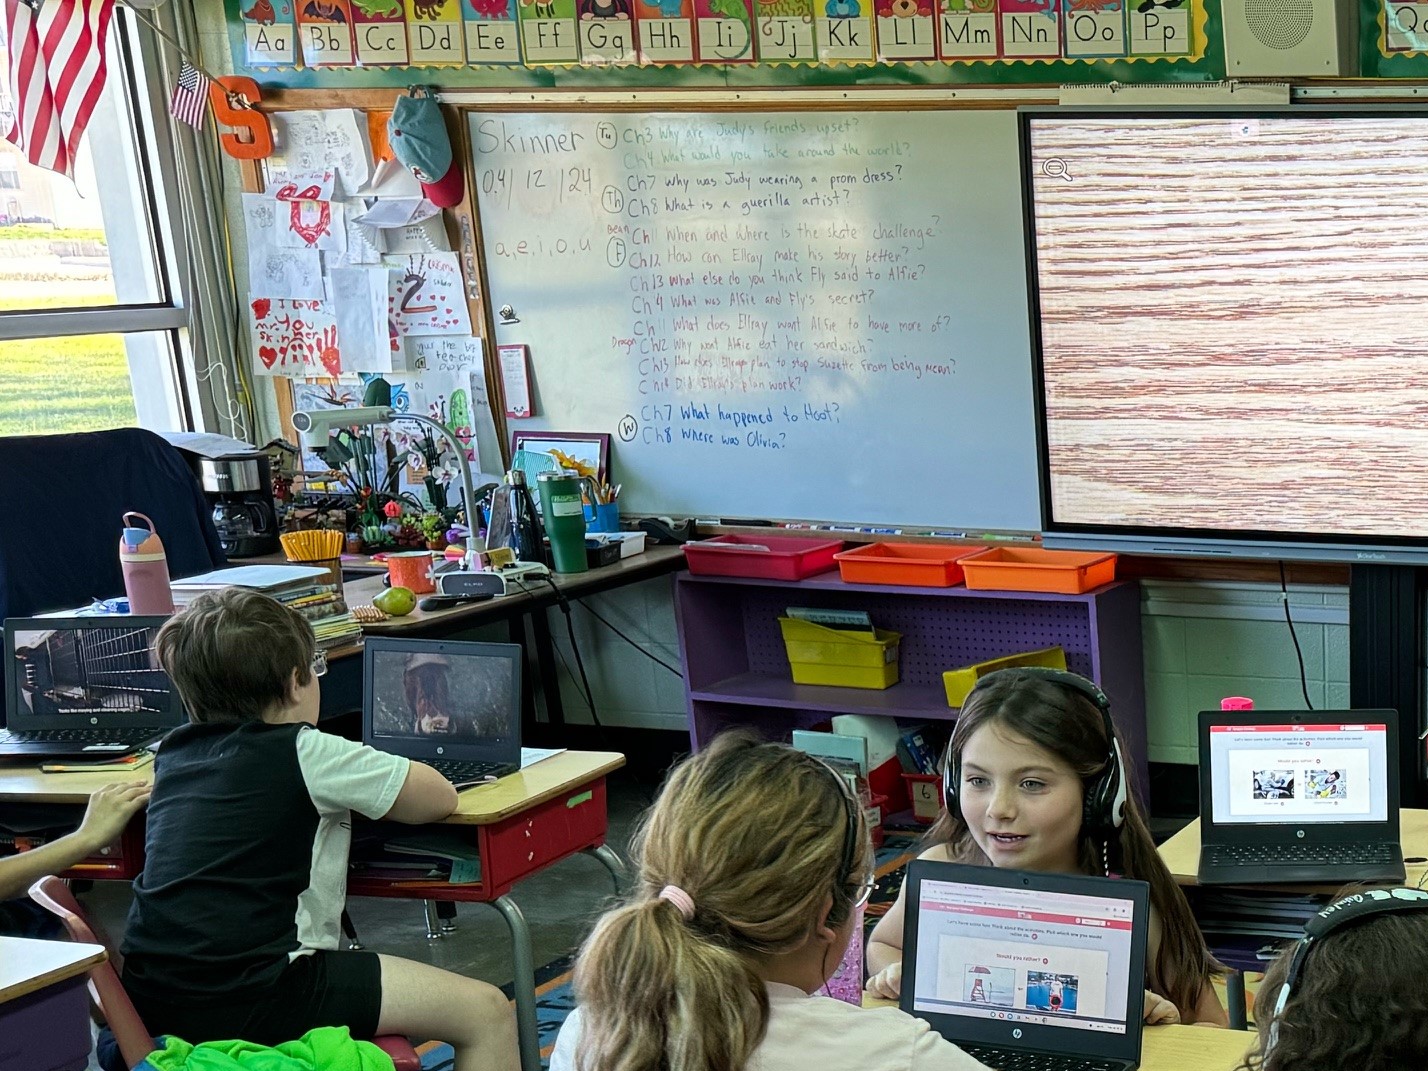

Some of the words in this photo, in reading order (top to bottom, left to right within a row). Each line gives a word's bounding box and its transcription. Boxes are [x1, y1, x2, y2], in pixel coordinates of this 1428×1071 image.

[254, 27, 286, 52] Aa
[310, 24, 341, 52] Bb
[365, 24, 397, 52] Cc
[419, 24, 452, 51] Dd
[477, 23, 505, 50] Ee
[537, 22, 560, 49] Ff
[588, 22, 625, 60] Gg
[649, 23, 682, 49] Hh
[716, 22, 733, 48] Ii
[775, 22, 798, 58] Jj
[828, 21, 859, 47] Kk
[945, 18, 990, 44] Mm
[1011, 16, 1048, 43] Nn
[1073, 14, 1114, 41] Oo
[1143, 13, 1175, 51] Pp
[478, 120, 584, 154] Skinner
[640, 403, 673, 422] Ch7
[681, 402, 710, 421] What
[717, 403, 773, 427] happened
[783, 406, 799, 422] to
[804, 401, 841, 424] Hoot?
[641, 426, 672, 445] Ch8
[681, 427, 714, 445] Where
[722, 434, 739, 447] was
[747, 428, 786, 449] Olivia?
